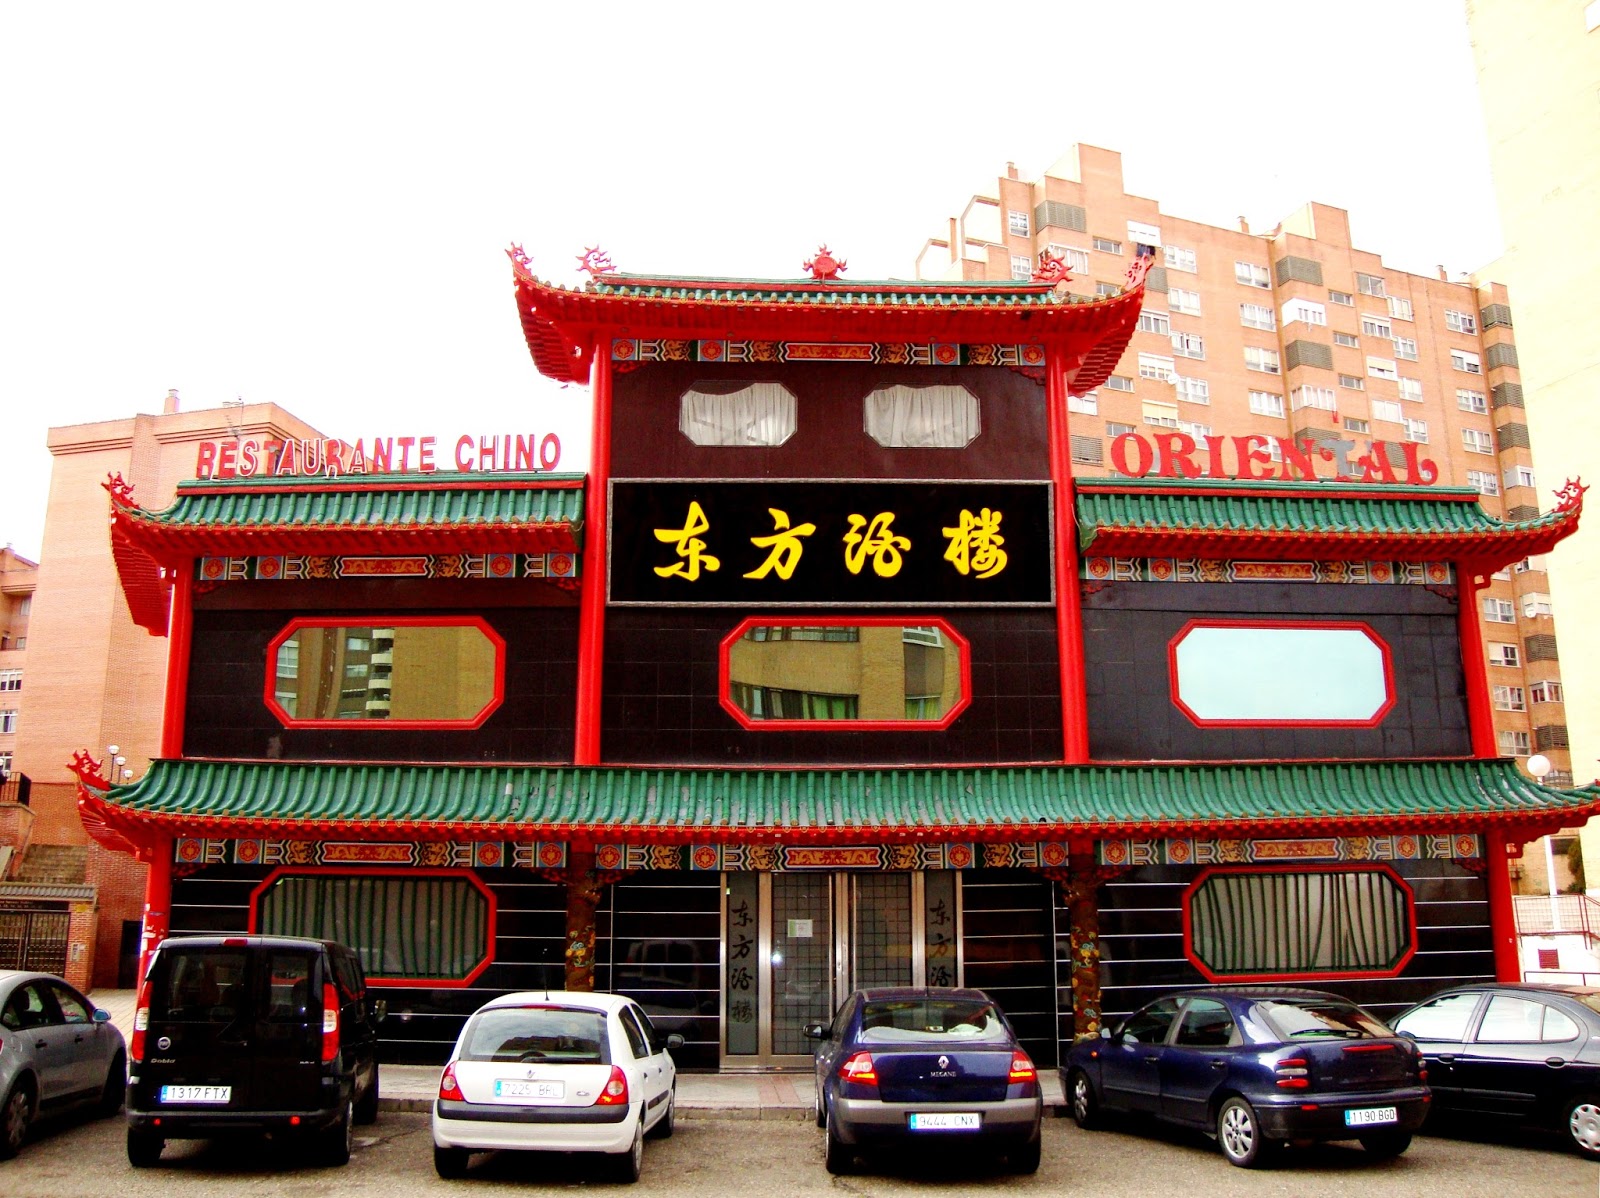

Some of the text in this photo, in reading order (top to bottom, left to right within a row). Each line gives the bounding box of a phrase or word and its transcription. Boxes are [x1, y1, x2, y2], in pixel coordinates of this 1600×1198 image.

[195, 432, 562, 481] RESTAURANTE CHINO
[1110, 432, 1439, 485] ORIENTAL
[171, 1087, 228, 1099] 1317 FTX
[504, 1084, 532, 1095] 7225
[919, 1115, 975, 1127] 9444 CNX
[1352, 1109, 1395, 1122] 1190 BGD
